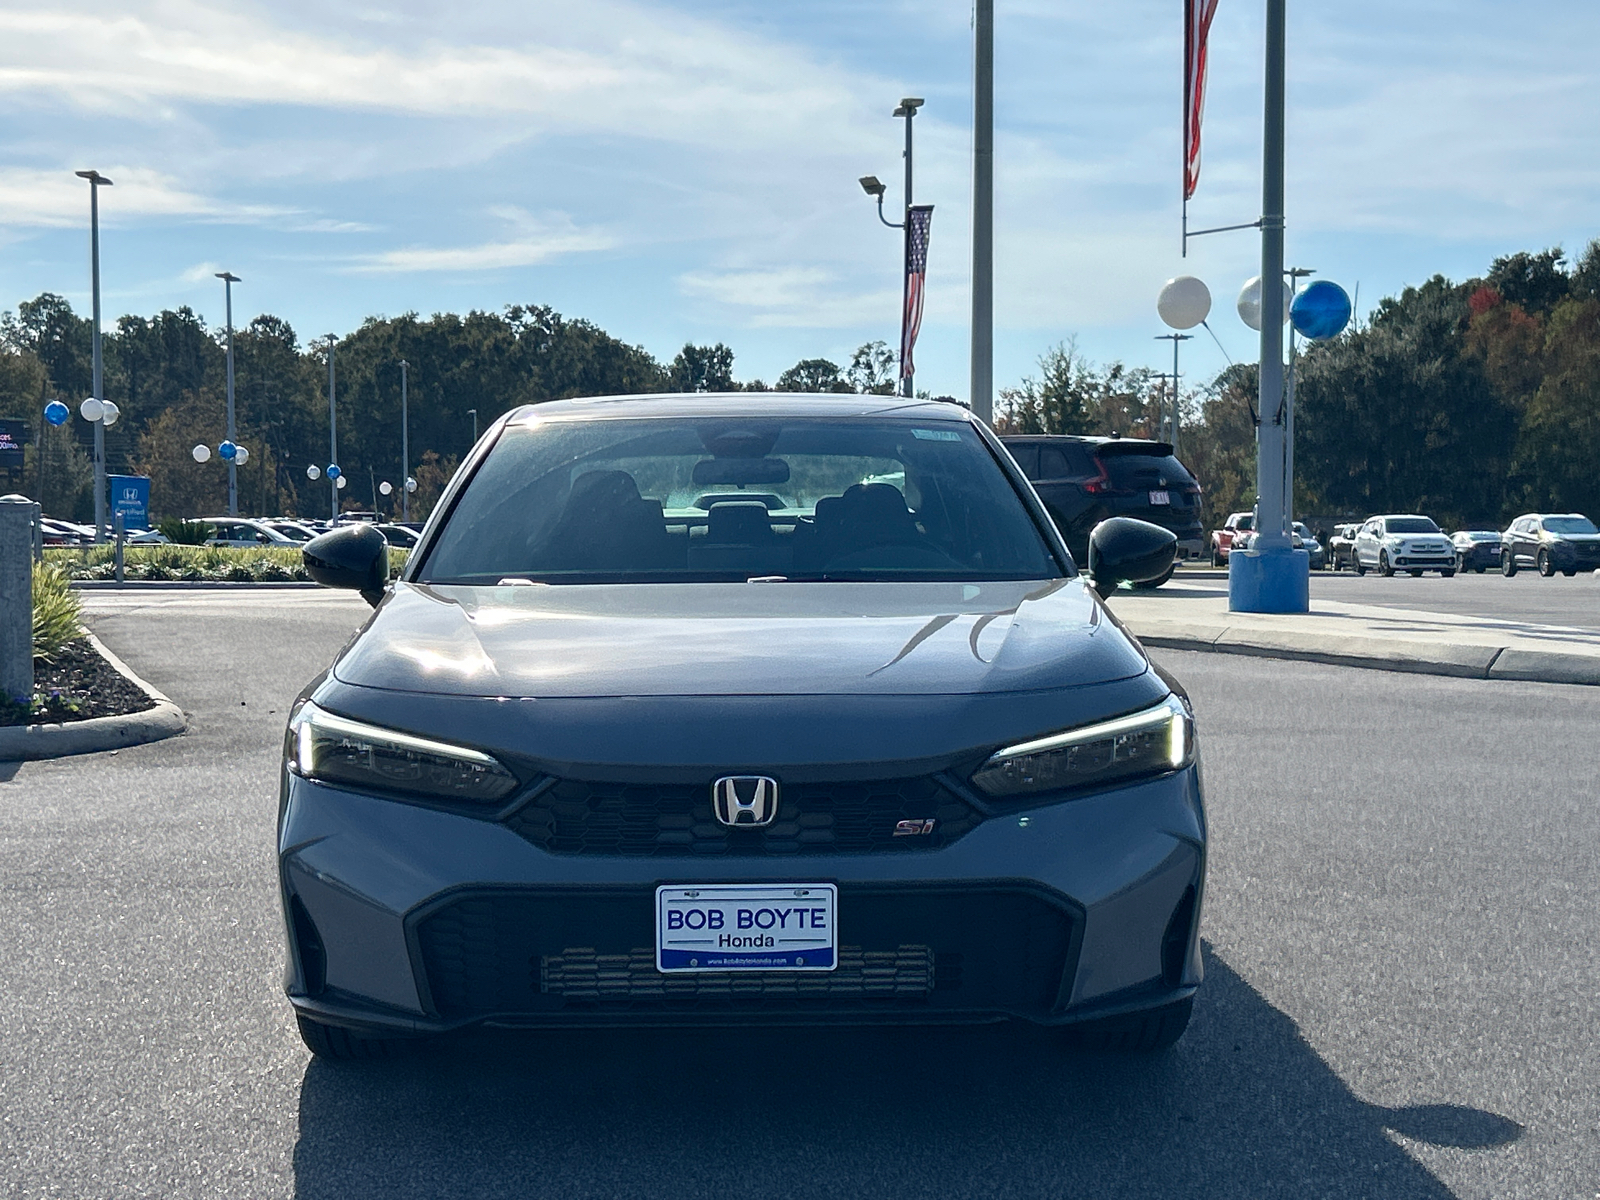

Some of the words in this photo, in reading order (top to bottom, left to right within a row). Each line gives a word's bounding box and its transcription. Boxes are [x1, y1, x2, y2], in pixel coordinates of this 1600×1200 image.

[892, 818, 936, 837] Si
[667, 909, 725, 930] BOB
[737, 908, 827, 930] BOYTE
[718, 933, 775, 948] Honda
